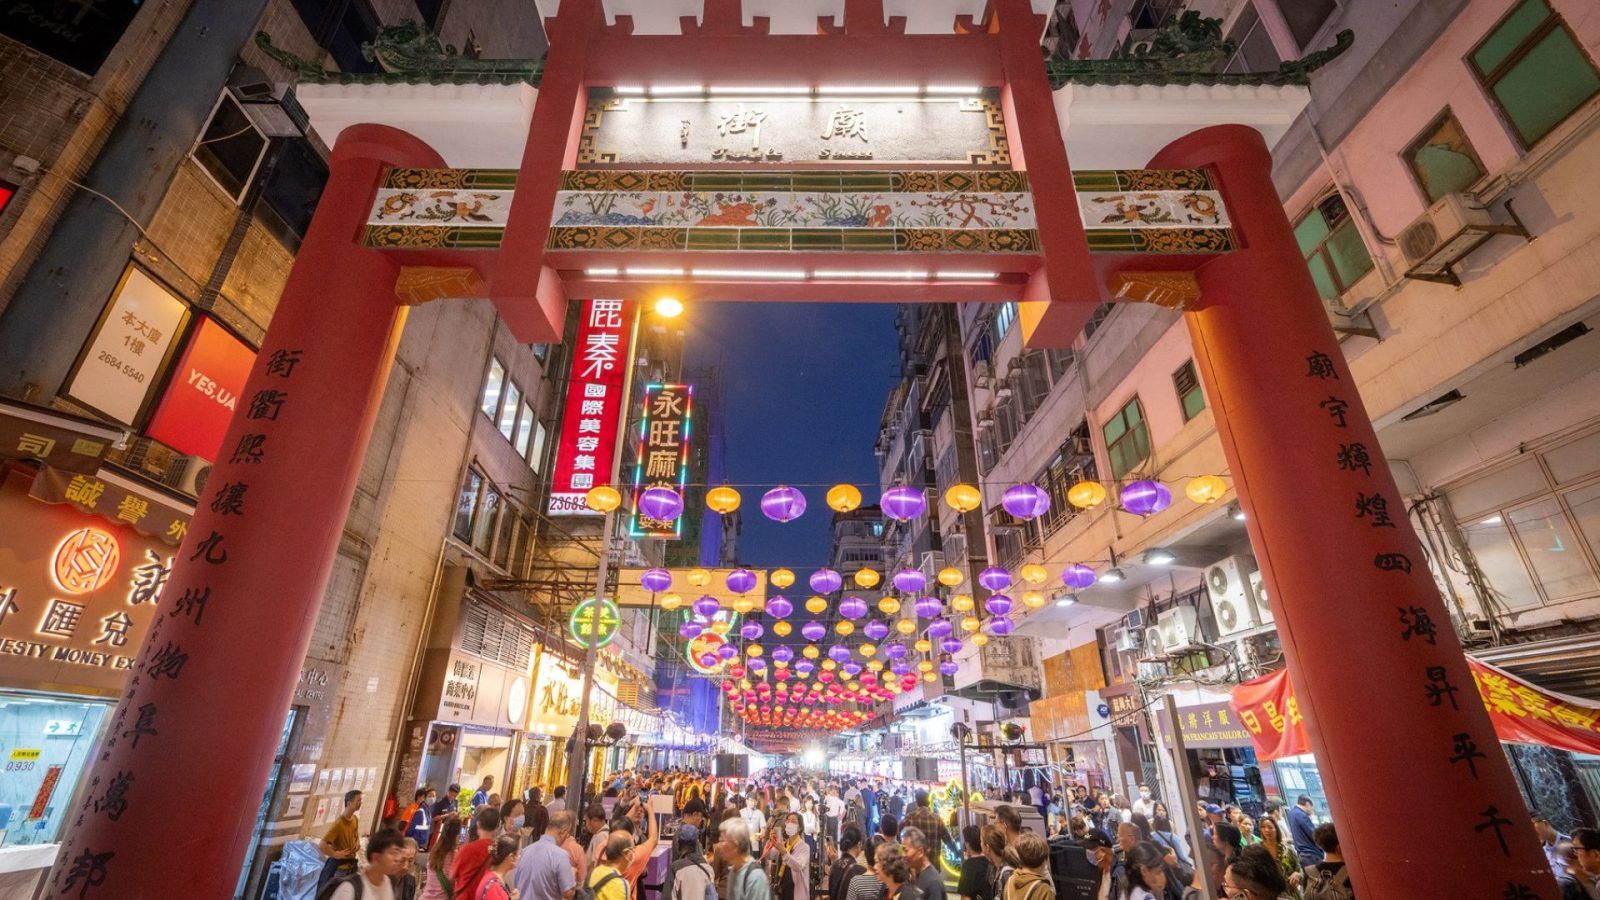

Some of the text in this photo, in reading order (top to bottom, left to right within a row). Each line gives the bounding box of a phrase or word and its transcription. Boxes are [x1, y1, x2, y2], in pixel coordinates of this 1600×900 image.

[98, 350, 145, 383] 2684 5540
[644, 391, 683, 490] 永旺麻
[53, 646, 111, 667] MONEY
